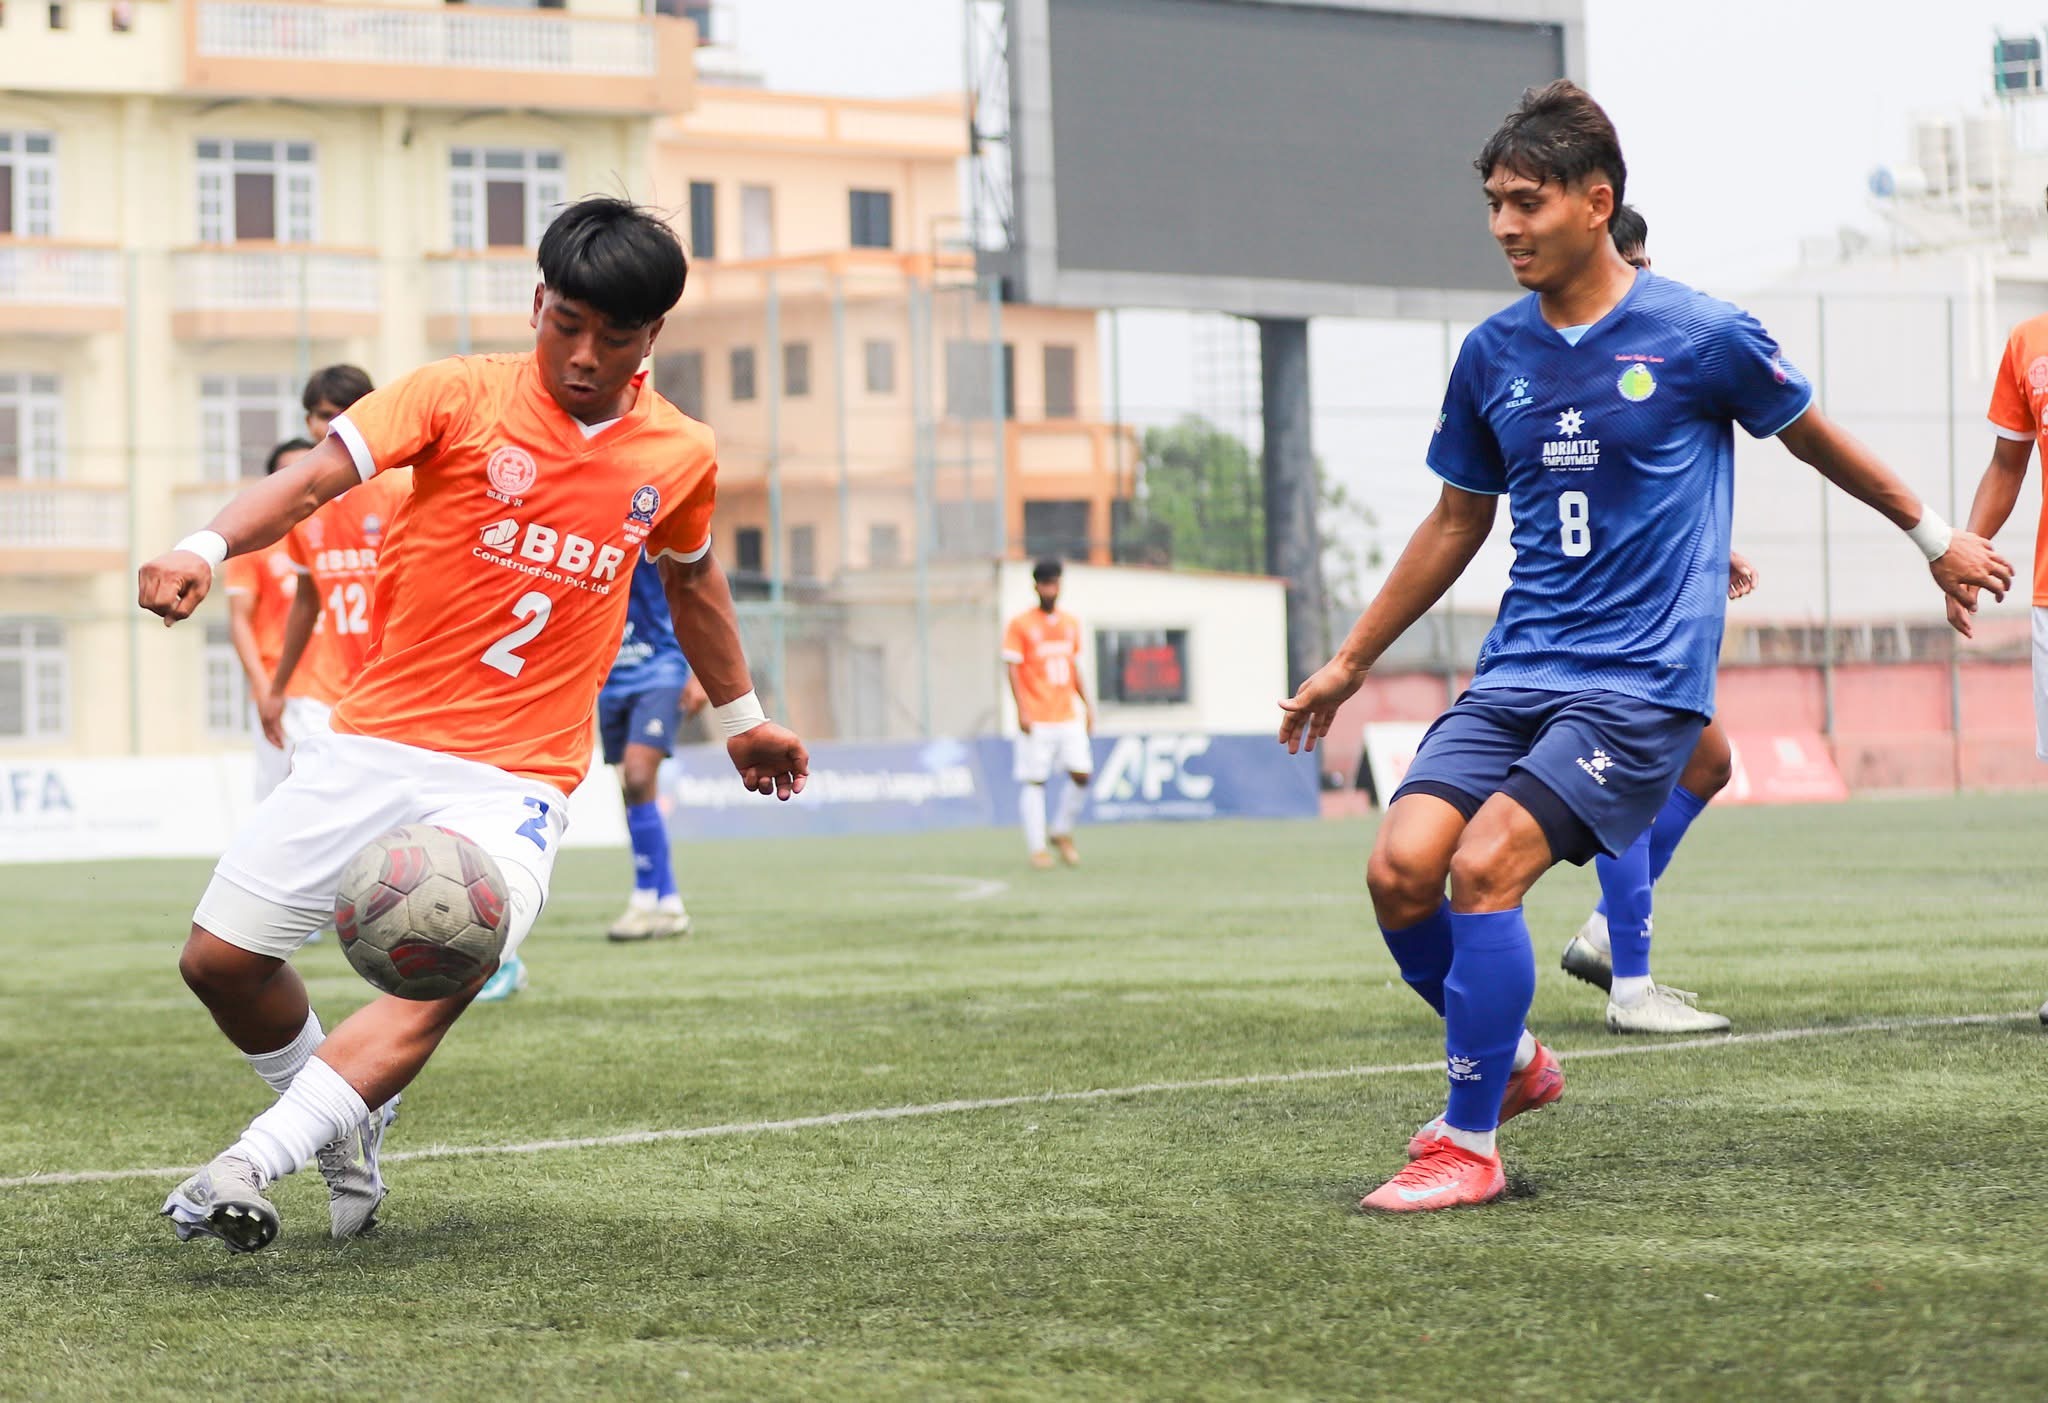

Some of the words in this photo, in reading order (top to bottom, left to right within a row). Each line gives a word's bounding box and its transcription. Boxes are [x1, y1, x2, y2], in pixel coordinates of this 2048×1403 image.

[1541, 454, 1600, 467] EMPLOYMENT
[1542, 439, 1600, 456] ADRIATIC
[1558, 490, 1592, 557] 8
[472, 547, 562, 583] Construction
[564, 575, 588, 590] Pvt.
[591, 582, 611, 595] Ltd
[519, 522, 626, 582] BBR
[328, 583, 369, 635] 12
[479, 591, 553, 679] 2
[0, 769, 75, 813] FA
[1094, 735, 1215, 801] AFC
[1575, 757, 1608, 786] KELME
[514, 796, 550, 852] 2
